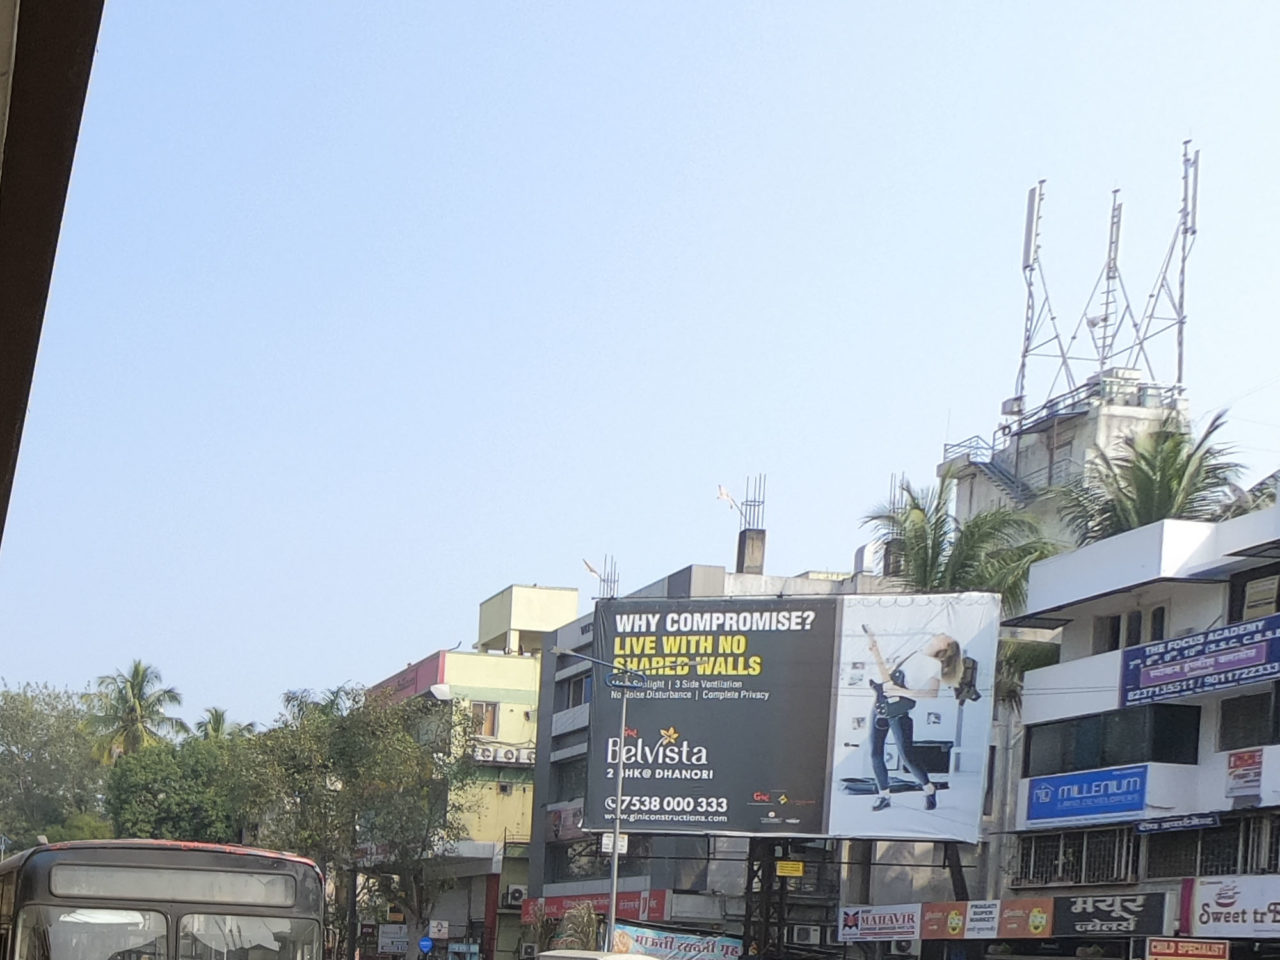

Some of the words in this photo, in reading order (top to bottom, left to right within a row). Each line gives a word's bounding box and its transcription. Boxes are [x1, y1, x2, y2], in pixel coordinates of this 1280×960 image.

[615, 613, 661, 633] WHY
[665, 610, 817, 632] COMPROMISE?
[613, 636, 657, 655] LIVE
[662, 635, 714, 654] WITH
[719, 634, 748, 654] NO
[1145, 642, 1166, 656] THE
[1167, 634, 1205, 651] FOCUS
[1207, 620, 1266, 642] ACADEMY
[612, 657, 690, 676] SHARED
[695, 656, 763, 676] WALLS
[682, 680, 700, 688] Side
[700, 679, 743, 689] Ventilation
[646, 690, 692, 700] Disturbance
[702, 690, 739, 700] Complete
[740, 690, 770, 701] Privacy
[606, 737, 709, 764] Belvista
[606, 768, 615, 778] 2
[655, 768, 713, 780] DHANORI
[1058, 776, 1141, 800] MILLENIUM
[620, 796, 660, 811] 7538
[662, 796, 695, 812] 000
[696, 797, 728, 813] 333
[1070, 894, 1147, 919] मयूर
[1198, 902, 1248, 925] Sweet
[860, 912, 916, 926] MAHAVIR
